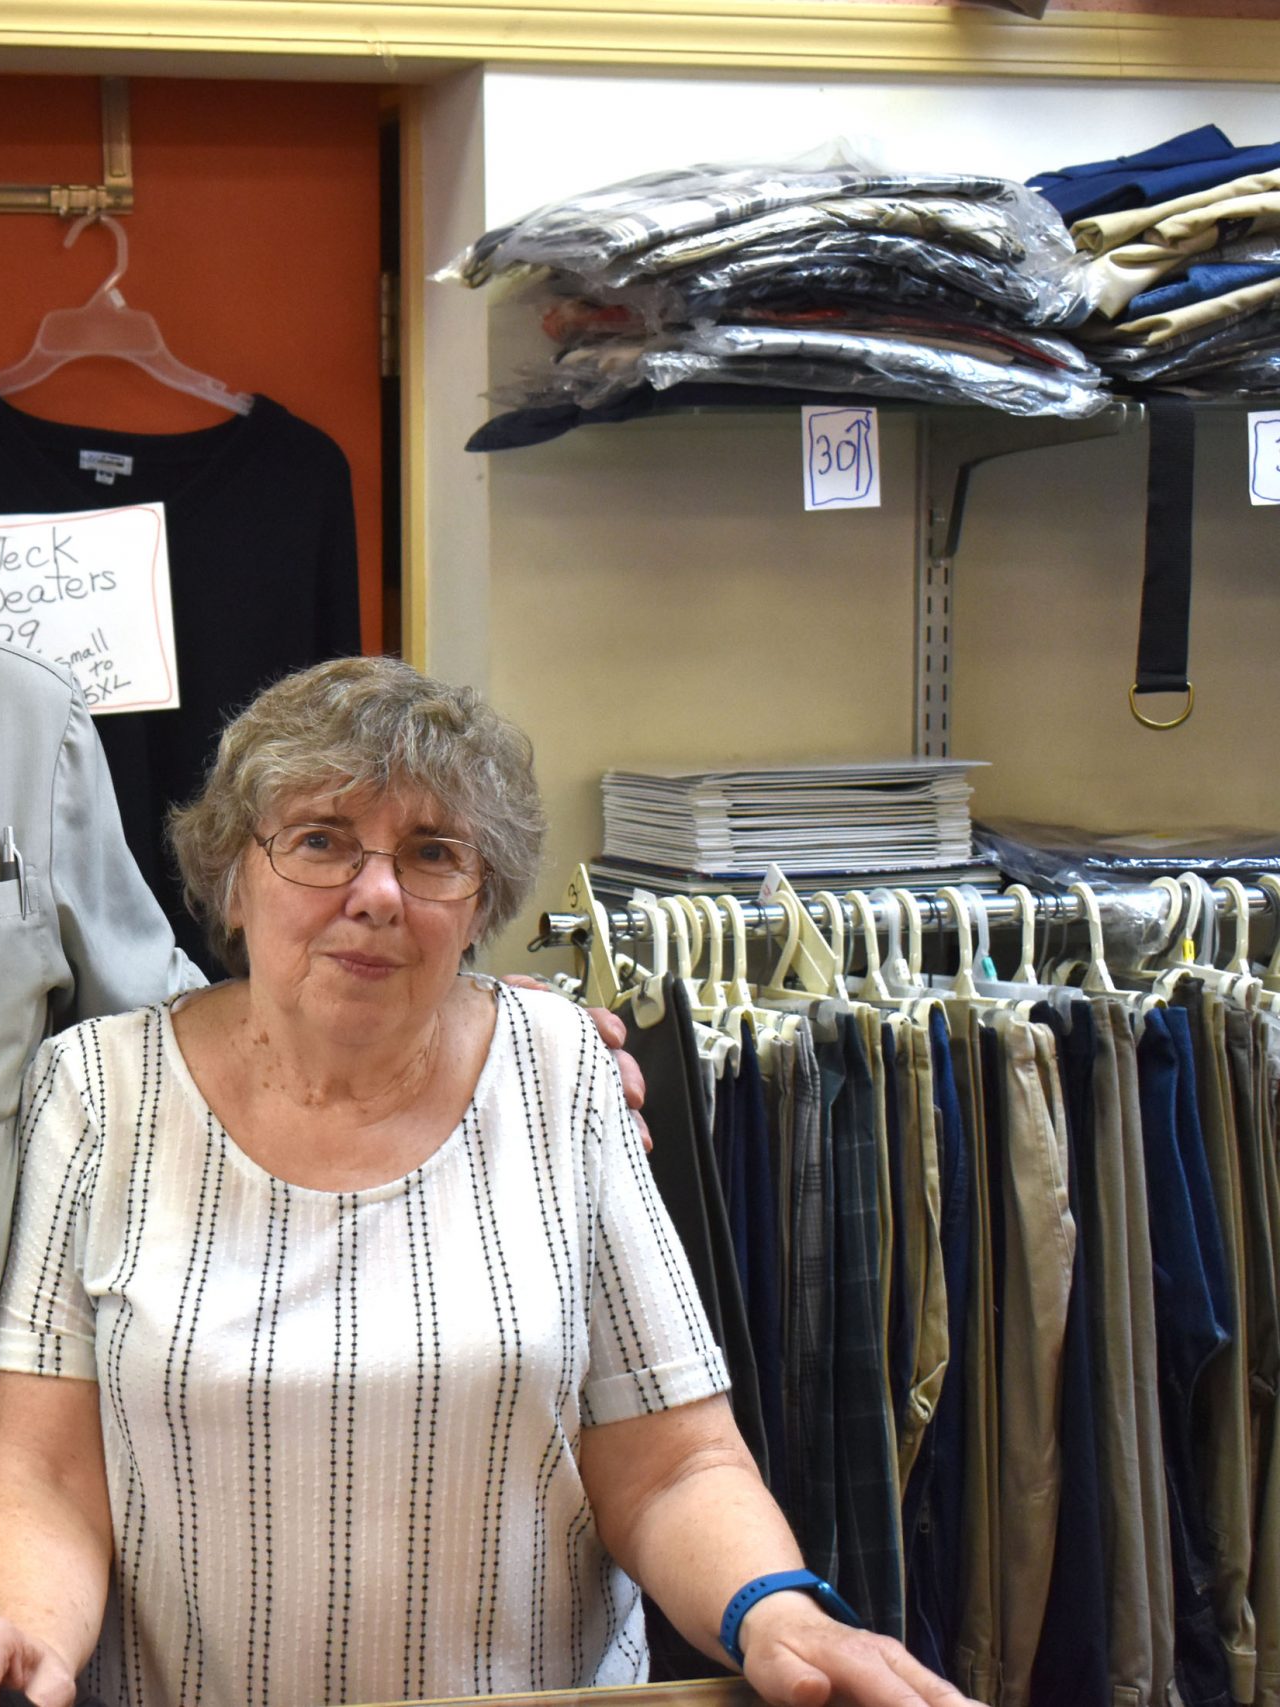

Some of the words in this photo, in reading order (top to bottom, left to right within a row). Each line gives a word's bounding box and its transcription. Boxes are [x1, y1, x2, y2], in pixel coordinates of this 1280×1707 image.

[816, 434, 857, 475] 30
[88, 660, 114, 678] to
[83, 674, 132, 706] 5XL
